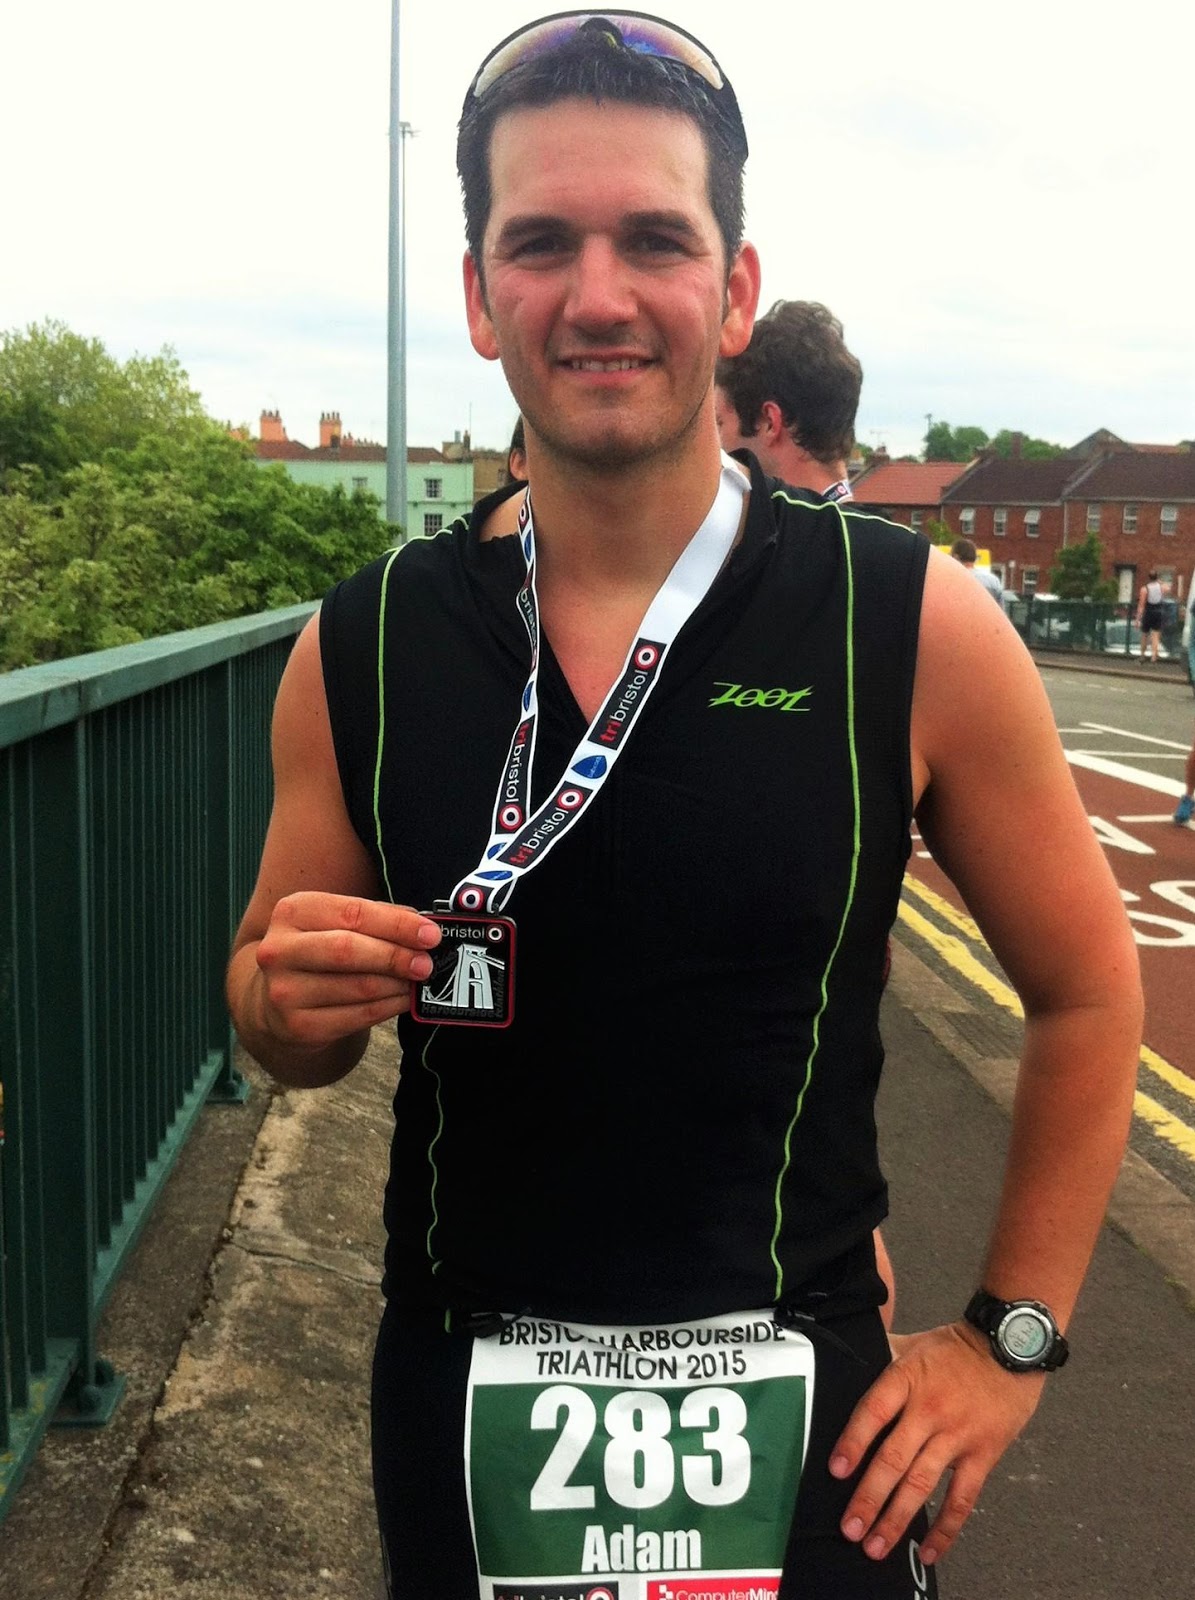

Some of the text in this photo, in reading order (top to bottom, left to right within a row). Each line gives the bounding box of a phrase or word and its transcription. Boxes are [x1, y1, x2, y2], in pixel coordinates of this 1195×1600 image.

[600, 669, 648, 742] tribristol
[505, 723, 531, 803] tribristol
[510, 807, 569, 863] tribristol
[441, 924, 485, 939] bristol
[536, 1350, 746, 1380] TRIATHLON 2015
[530, 1385, 752, 1511] 283
[581, 1524, 702, 1573] Adam
